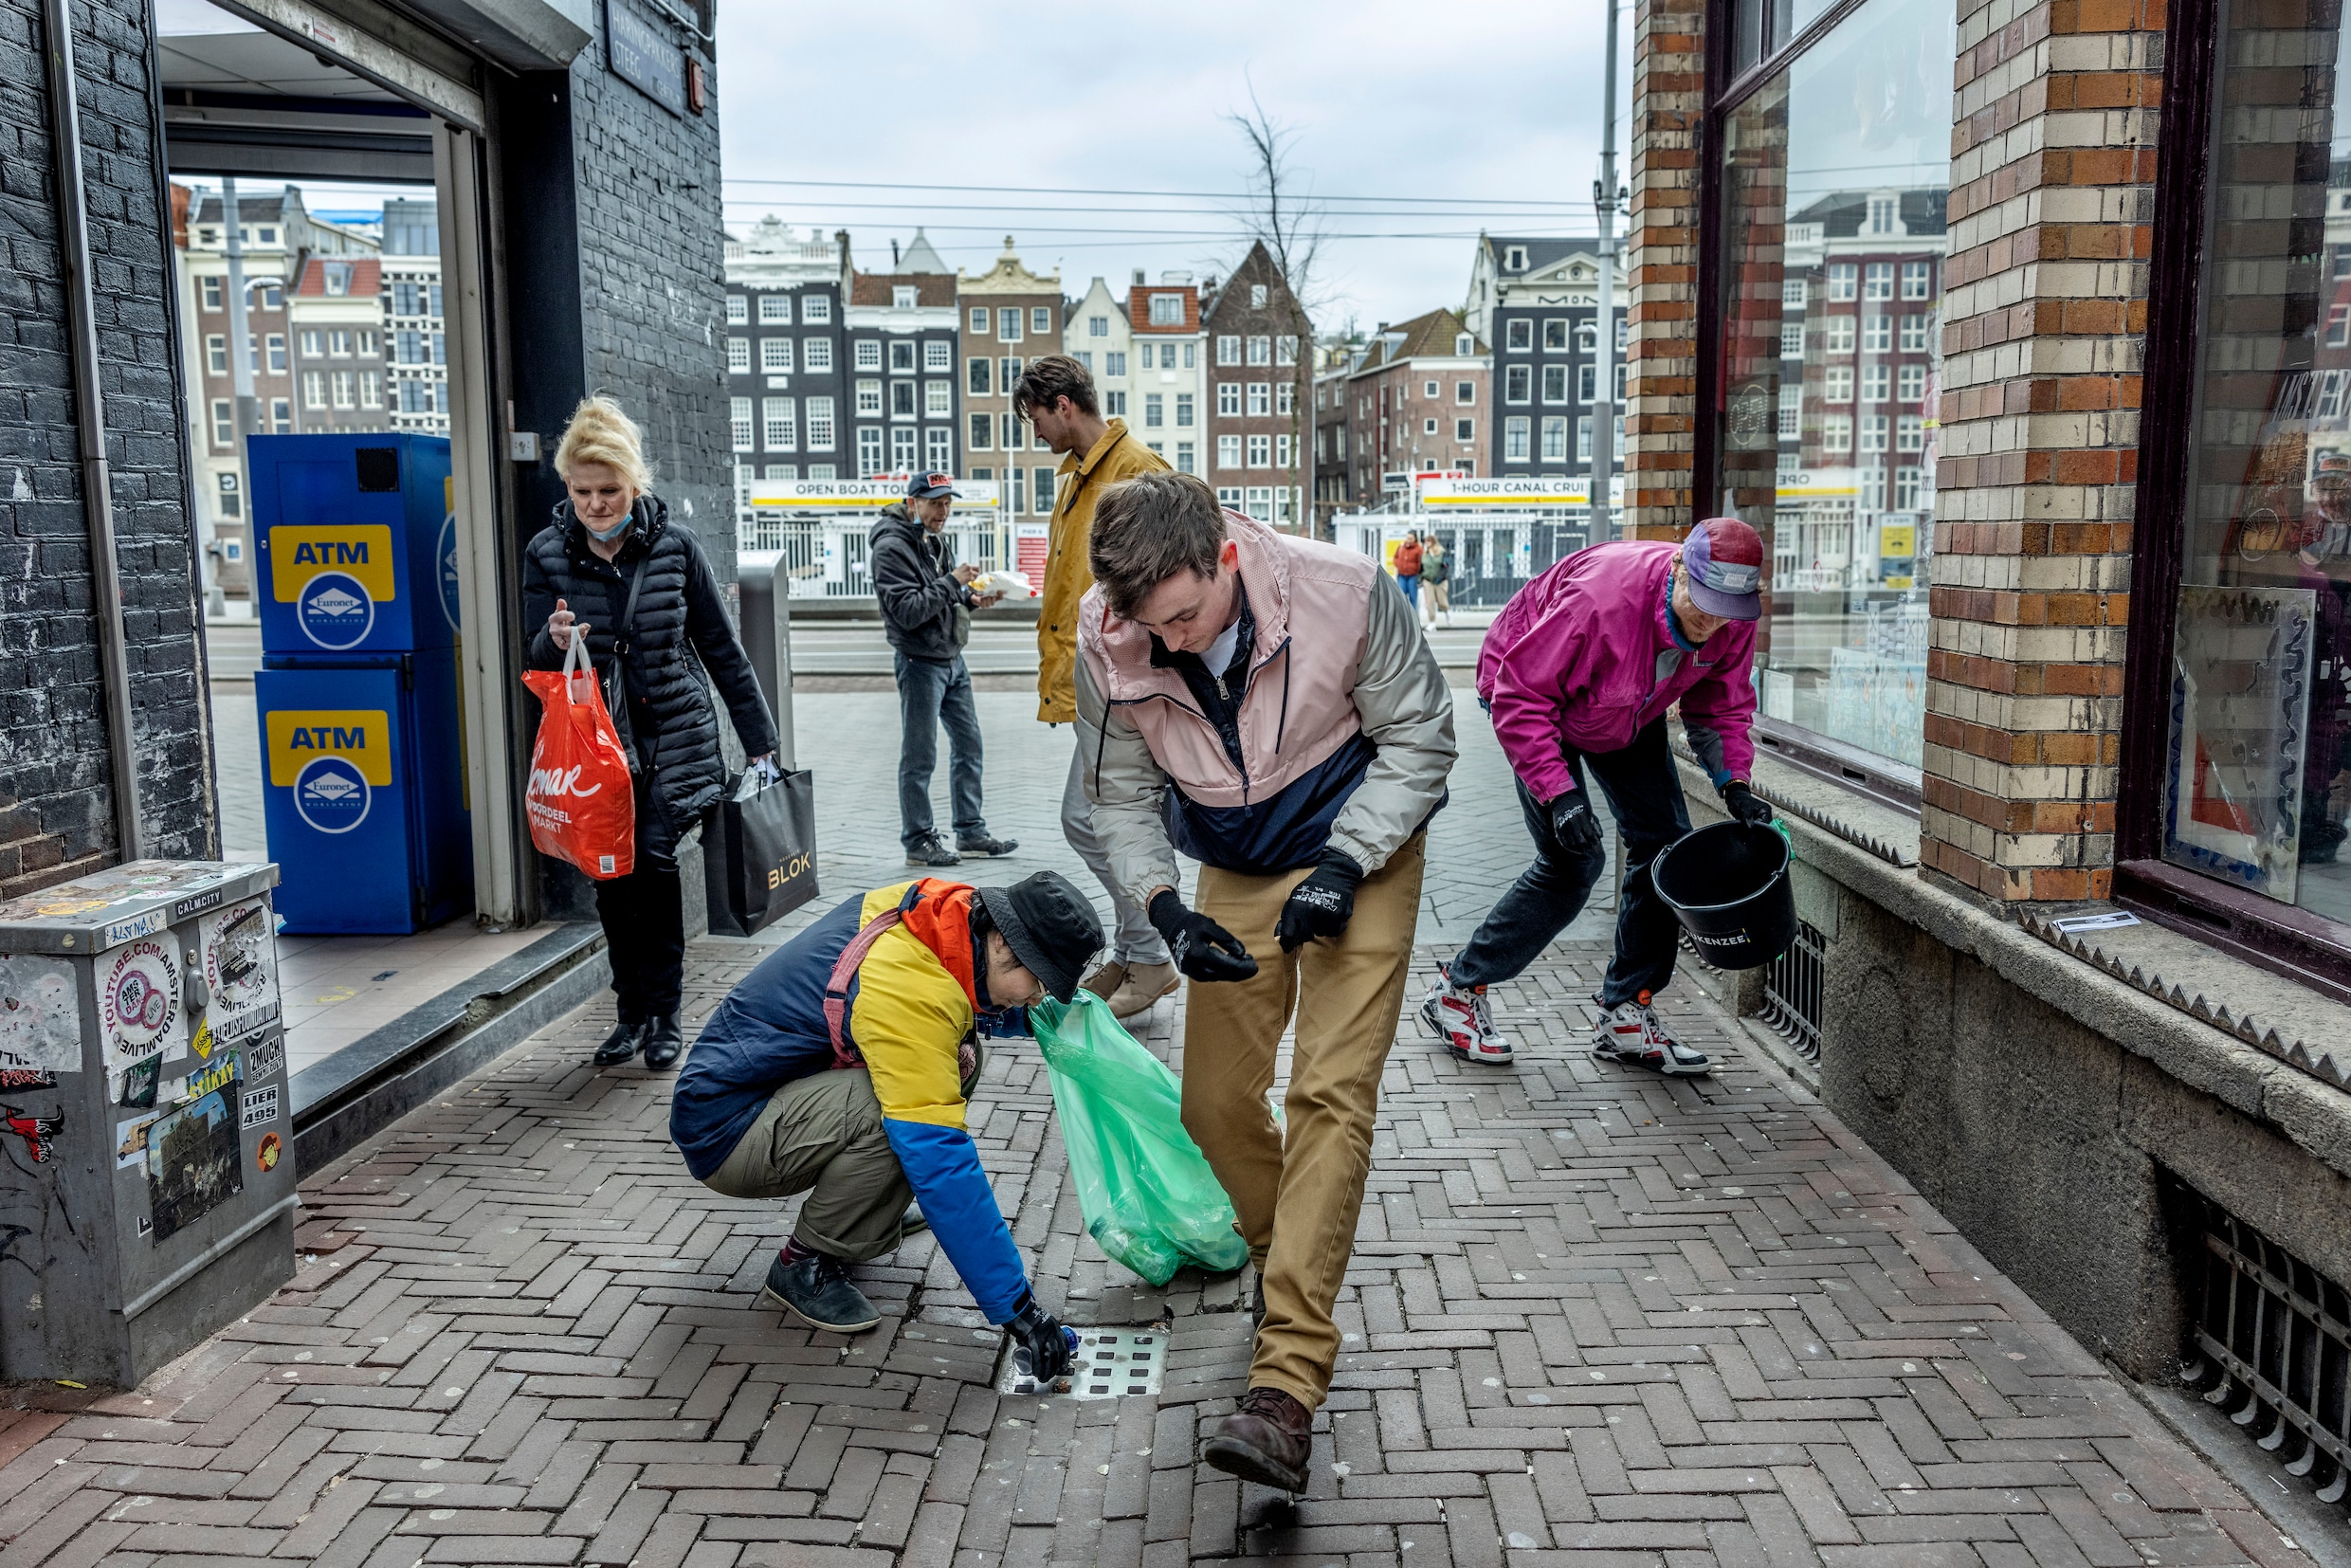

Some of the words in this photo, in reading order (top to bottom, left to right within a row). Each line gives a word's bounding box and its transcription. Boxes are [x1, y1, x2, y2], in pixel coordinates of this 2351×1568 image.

[614, 40, 642, 80] STEEG
[796, 483, 834, 495] OPEN
[839, 483, 877, 495] BOAT
[883, 483, 909, 495] TOU
[1452, 483, 1499, 494] 1-HOUR
[1504, 482, 1549, 493] CANAL
[293, 541, 370, 566] ATM
[317, 596, 355, 608] Euronet
[289, 727, 366, 750] ATM
[313, 781, 351, 792] Euronet
[528, 797, 572, 824] VOORDEEL
[534, 814, 562, 834] MARKT
[768, 851, 811, 891] BLOK
[177, 891, 221, 916] CALMCITY
[121, 979, 139, 1000] AMS
[123, 990, 141, 1007] TER
[146, 999, 161, 1021] LIVE
[250, 1037, 281, 1071] 2MUCH
[245, 1089, 277, 1107] LIER
[244, 1105, 276, 1123] 495
